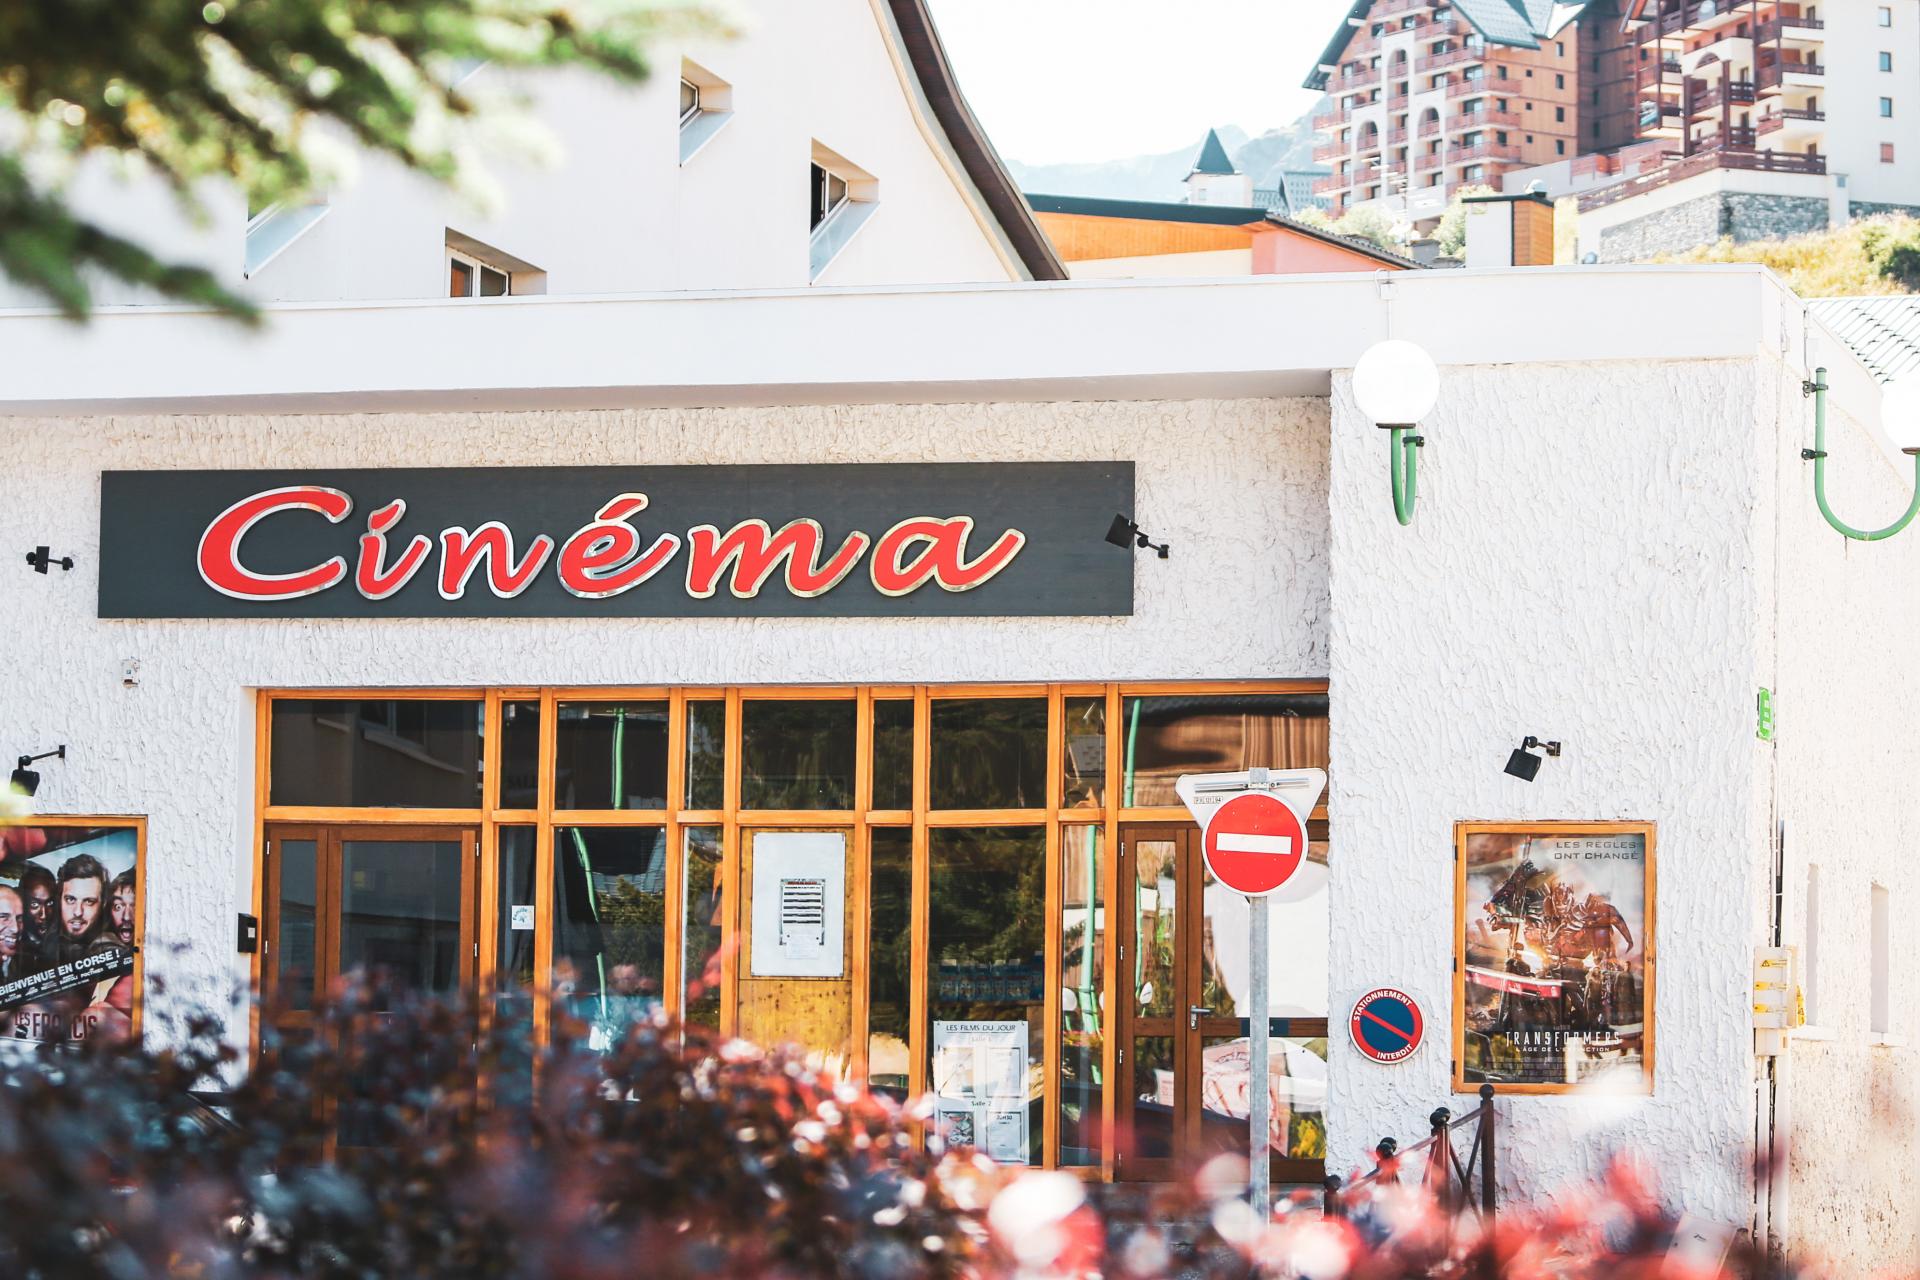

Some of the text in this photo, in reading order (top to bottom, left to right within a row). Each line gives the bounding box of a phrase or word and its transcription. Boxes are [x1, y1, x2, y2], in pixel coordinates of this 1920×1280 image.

[196, 486, 1026, 600] Cinéma
[1556, 841, 1580, 849] LES
[1554, 852, 1580, 860] ONT
[0, 968, 56, 996] BIENVENUE
[57, 963, 73, 976] EN
[75, 950, 114, 970] CORSE
[115, 948, 121, 958] !
[1354, 990, 1413, 1021] STATIONNEMENT
[14, 1012, 31, 1027] LES
[1376, 1043, 1413, 1060] INTERDIT
